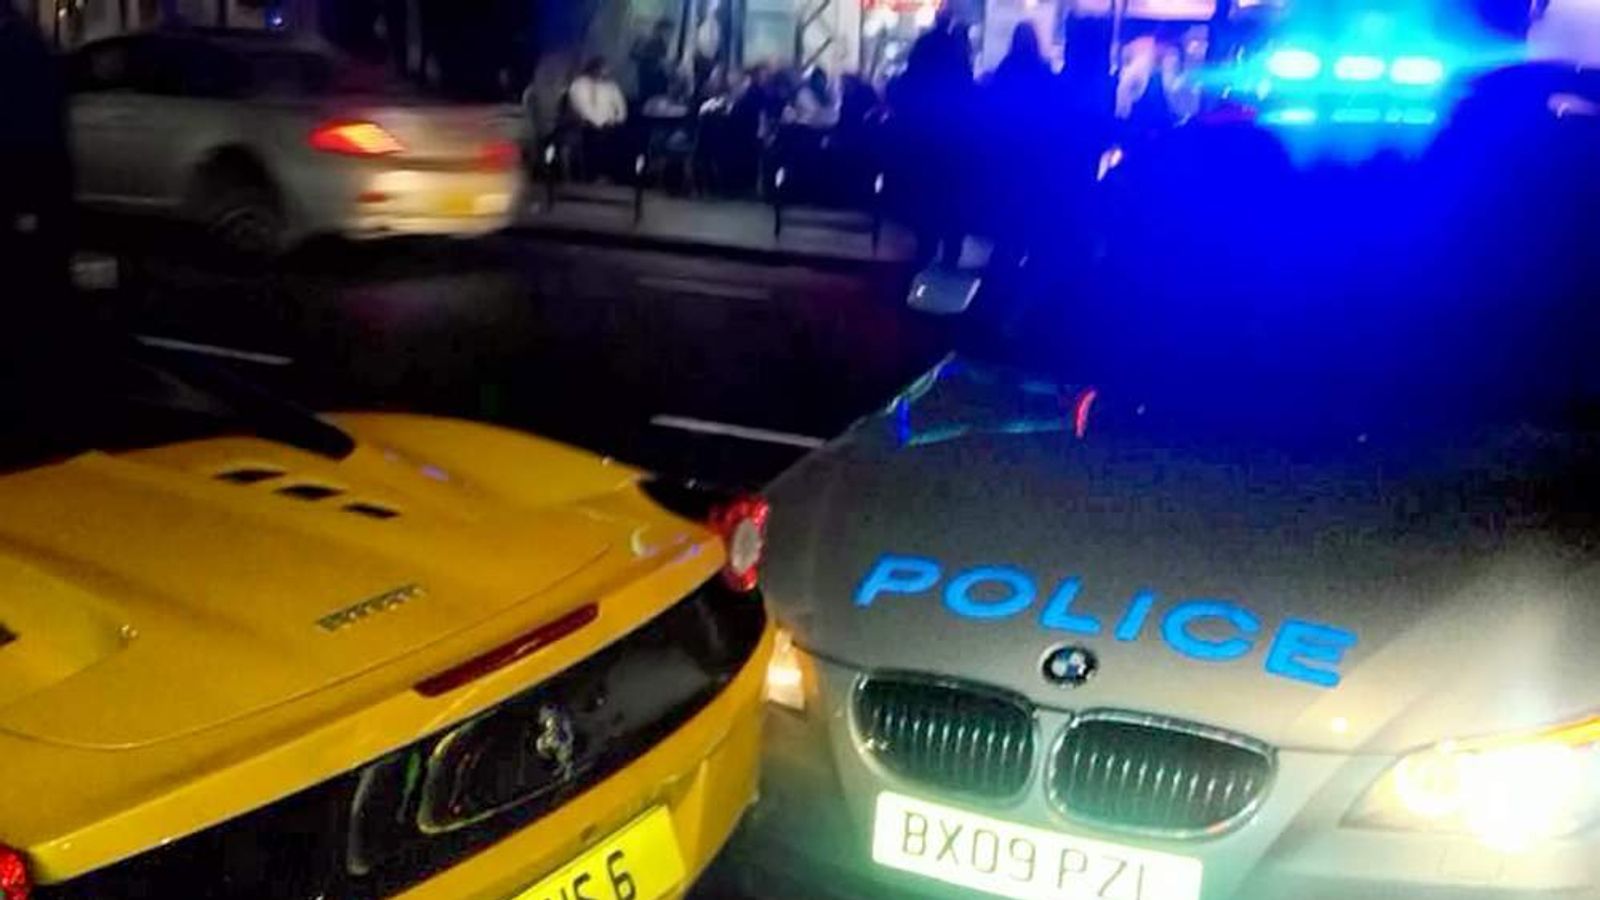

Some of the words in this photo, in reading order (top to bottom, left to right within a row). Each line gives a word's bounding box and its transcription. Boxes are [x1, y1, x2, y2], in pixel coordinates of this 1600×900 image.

[854, 552, 1358, 687] POLICE
[606, 849, 636, 900] 6
[901, 810, 1037, 883] BX09
